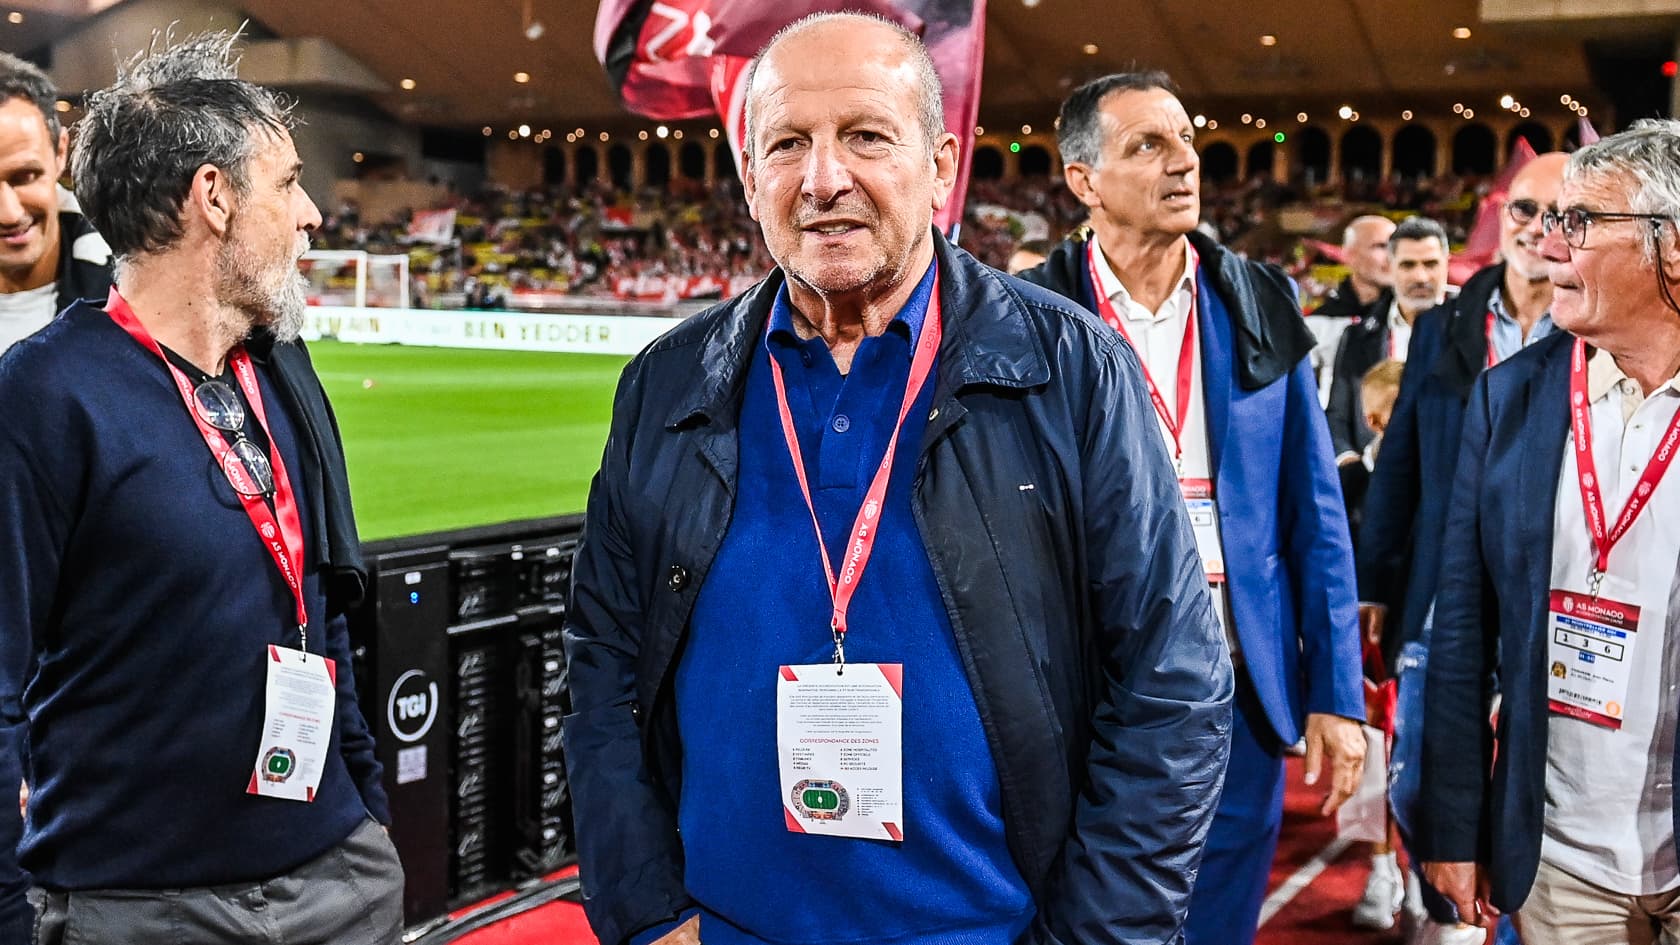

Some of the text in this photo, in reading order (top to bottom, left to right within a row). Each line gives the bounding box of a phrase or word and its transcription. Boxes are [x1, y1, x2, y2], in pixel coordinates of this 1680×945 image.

[271, 541, 298, 589] AS MONACO
[845, 523, 869, 585] AS MONACO
[1588, 605, 1624, 619] MONACO
[1583, 639, 1589, 647] 3
[1604, 645, 1611, 654] 6
[397, 692, 427, 720] TGI
